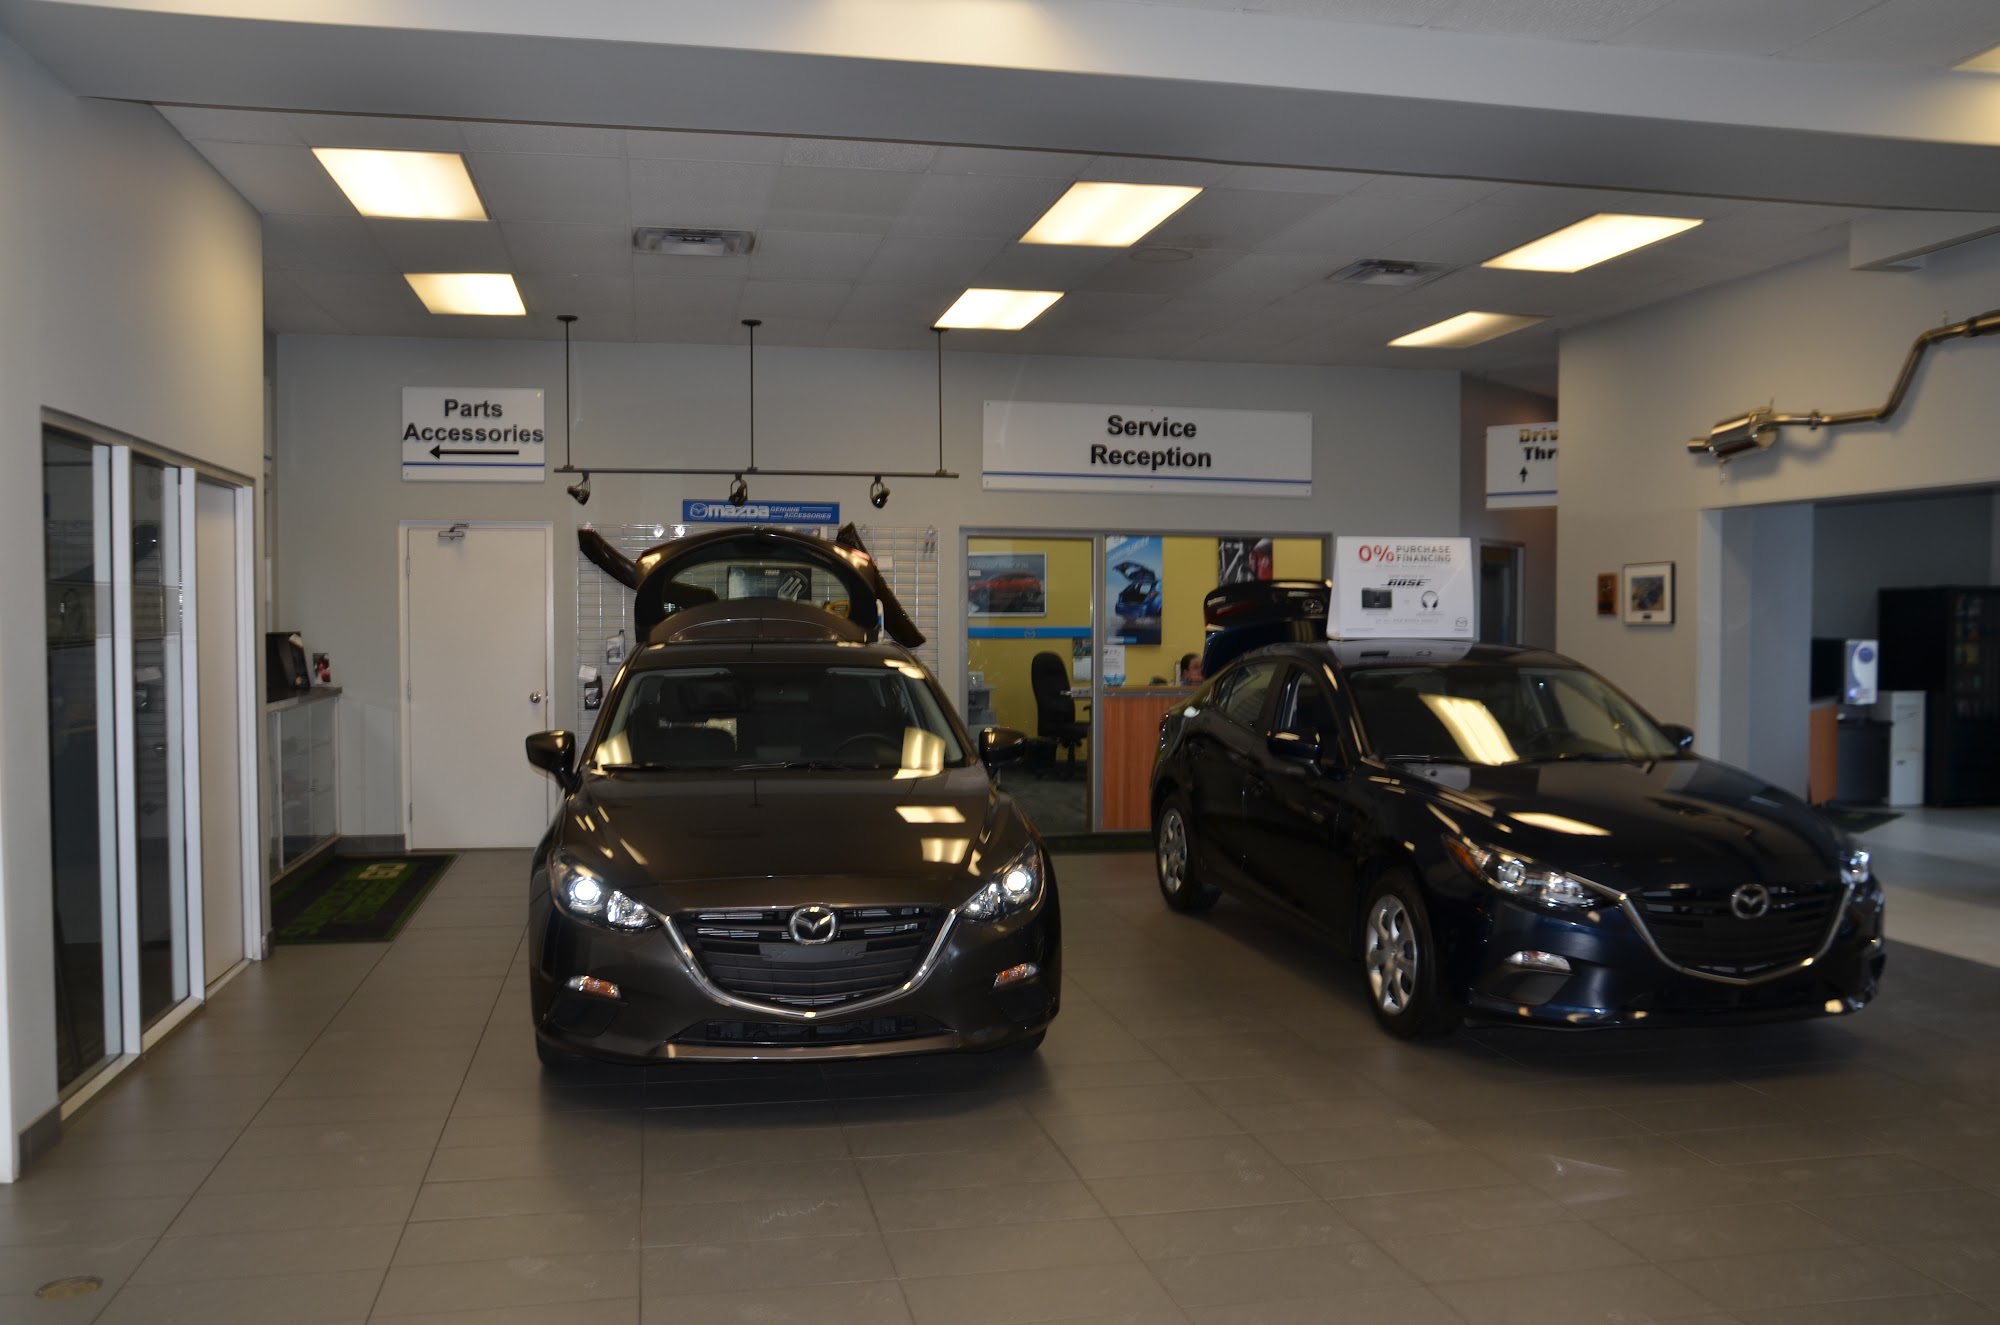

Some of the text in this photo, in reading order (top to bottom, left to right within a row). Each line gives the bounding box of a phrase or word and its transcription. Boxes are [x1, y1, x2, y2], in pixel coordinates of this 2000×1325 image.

[444, 399, 503, 418] Parts
[403, 422, 544, 443] Accessories
[1107, 415, 1197, 438] Service
[1519, 427, 1559, 442] Driv
[1091, 444, 1212, 471] Reception
[1525, 446, 1559, 460] Thr
[1359, 545, 1395, 562] 0%
[1396, 545, 1451, 554] PURCHASE
[1396, 554, 1452, 563] FINANCING
[1385, 579, 1429, 587] BOSE
